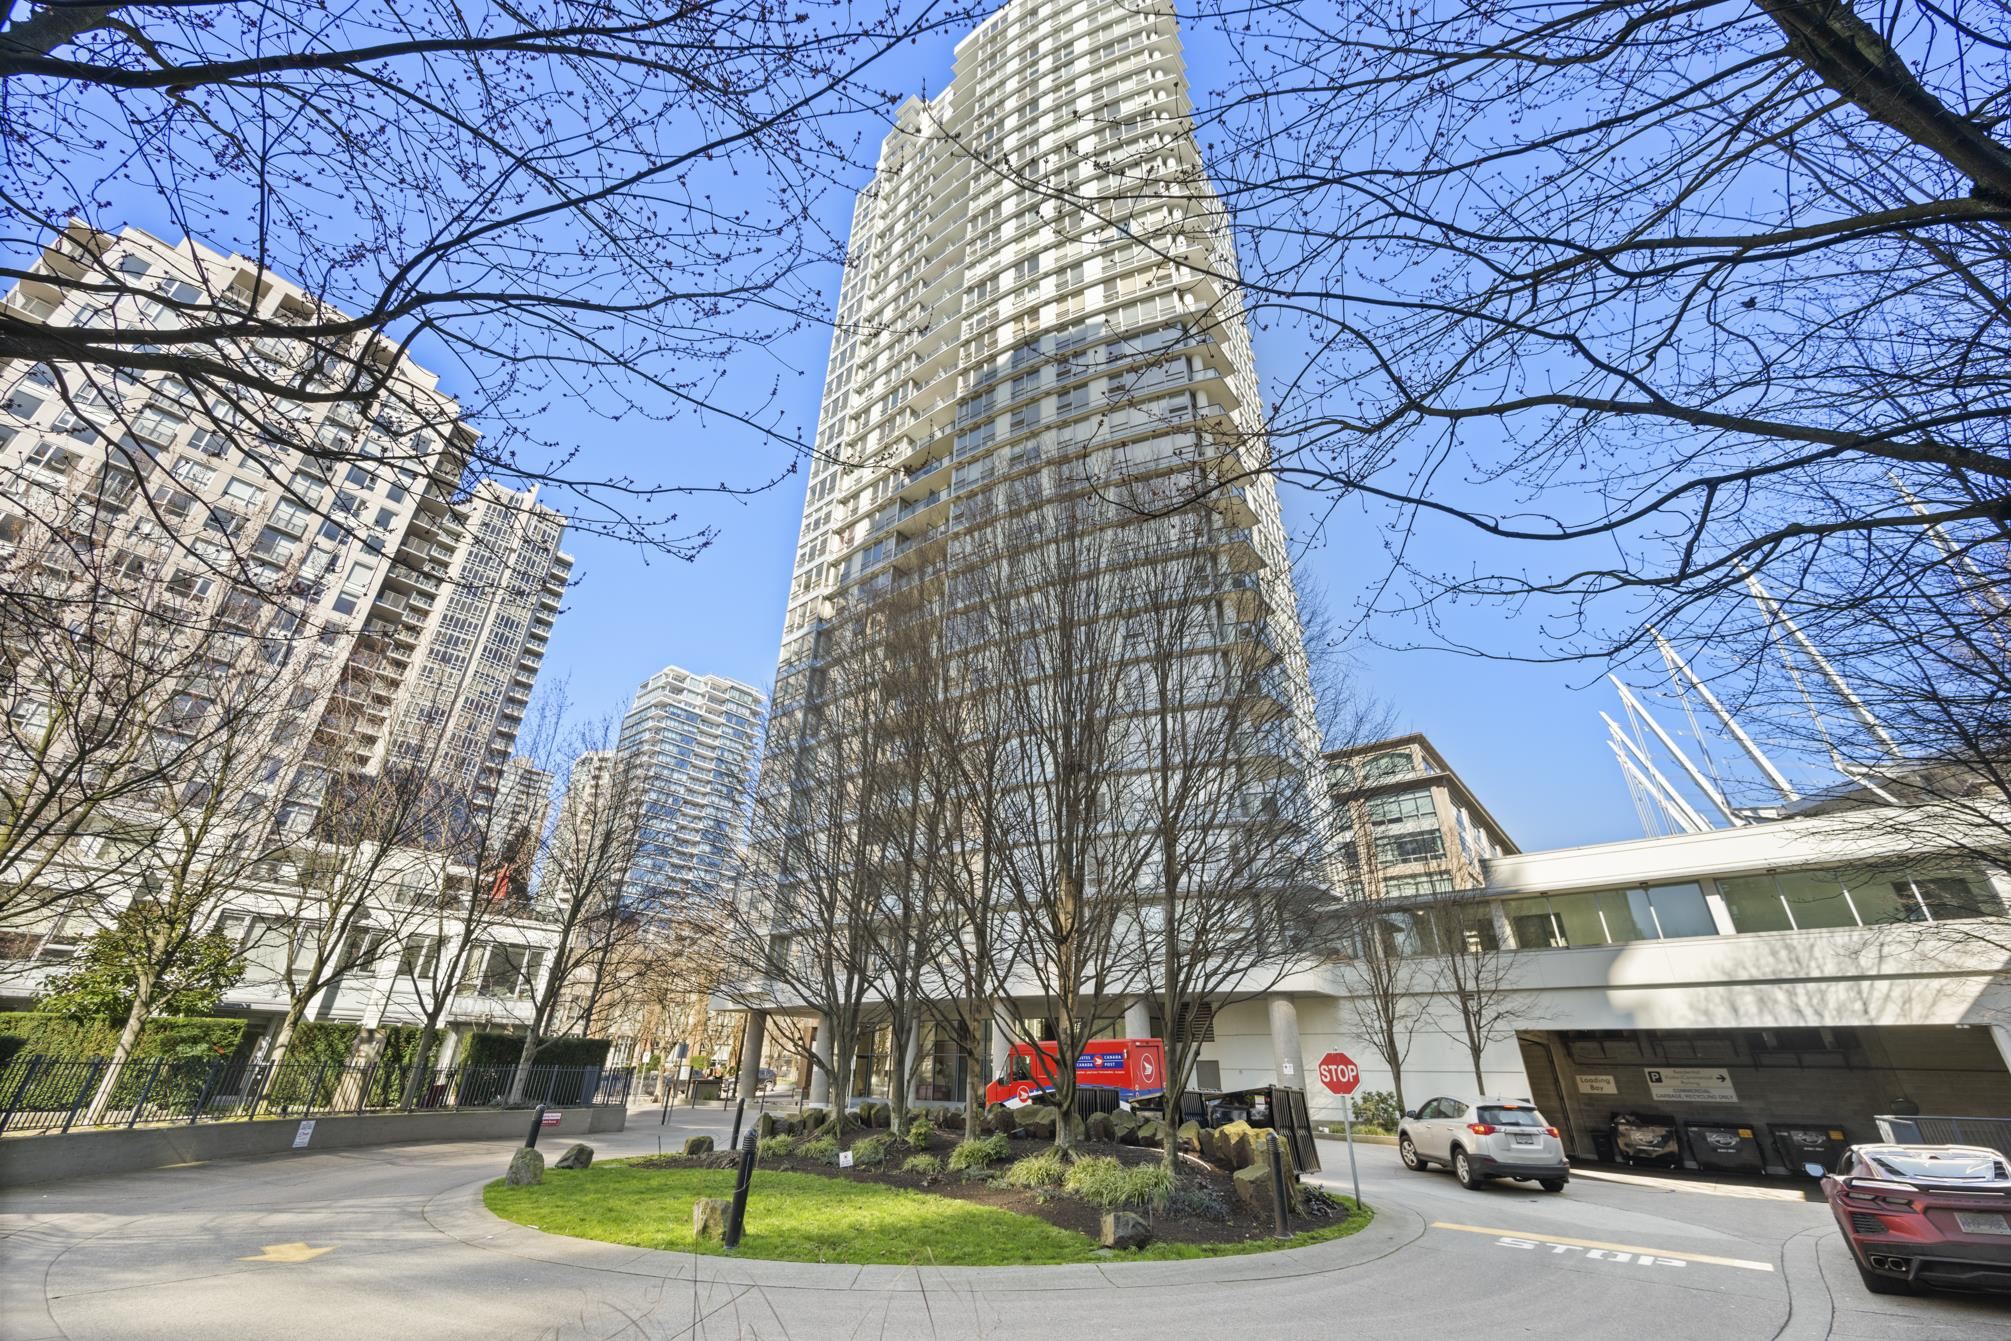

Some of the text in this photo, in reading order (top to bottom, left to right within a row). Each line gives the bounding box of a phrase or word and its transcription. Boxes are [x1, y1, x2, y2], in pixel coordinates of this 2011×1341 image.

[1320, 1064, 1357, 1082] STOP
[1579, 1076, 1611, 1084] Loading
[1494, 1236, 1687, 1267] STOP
